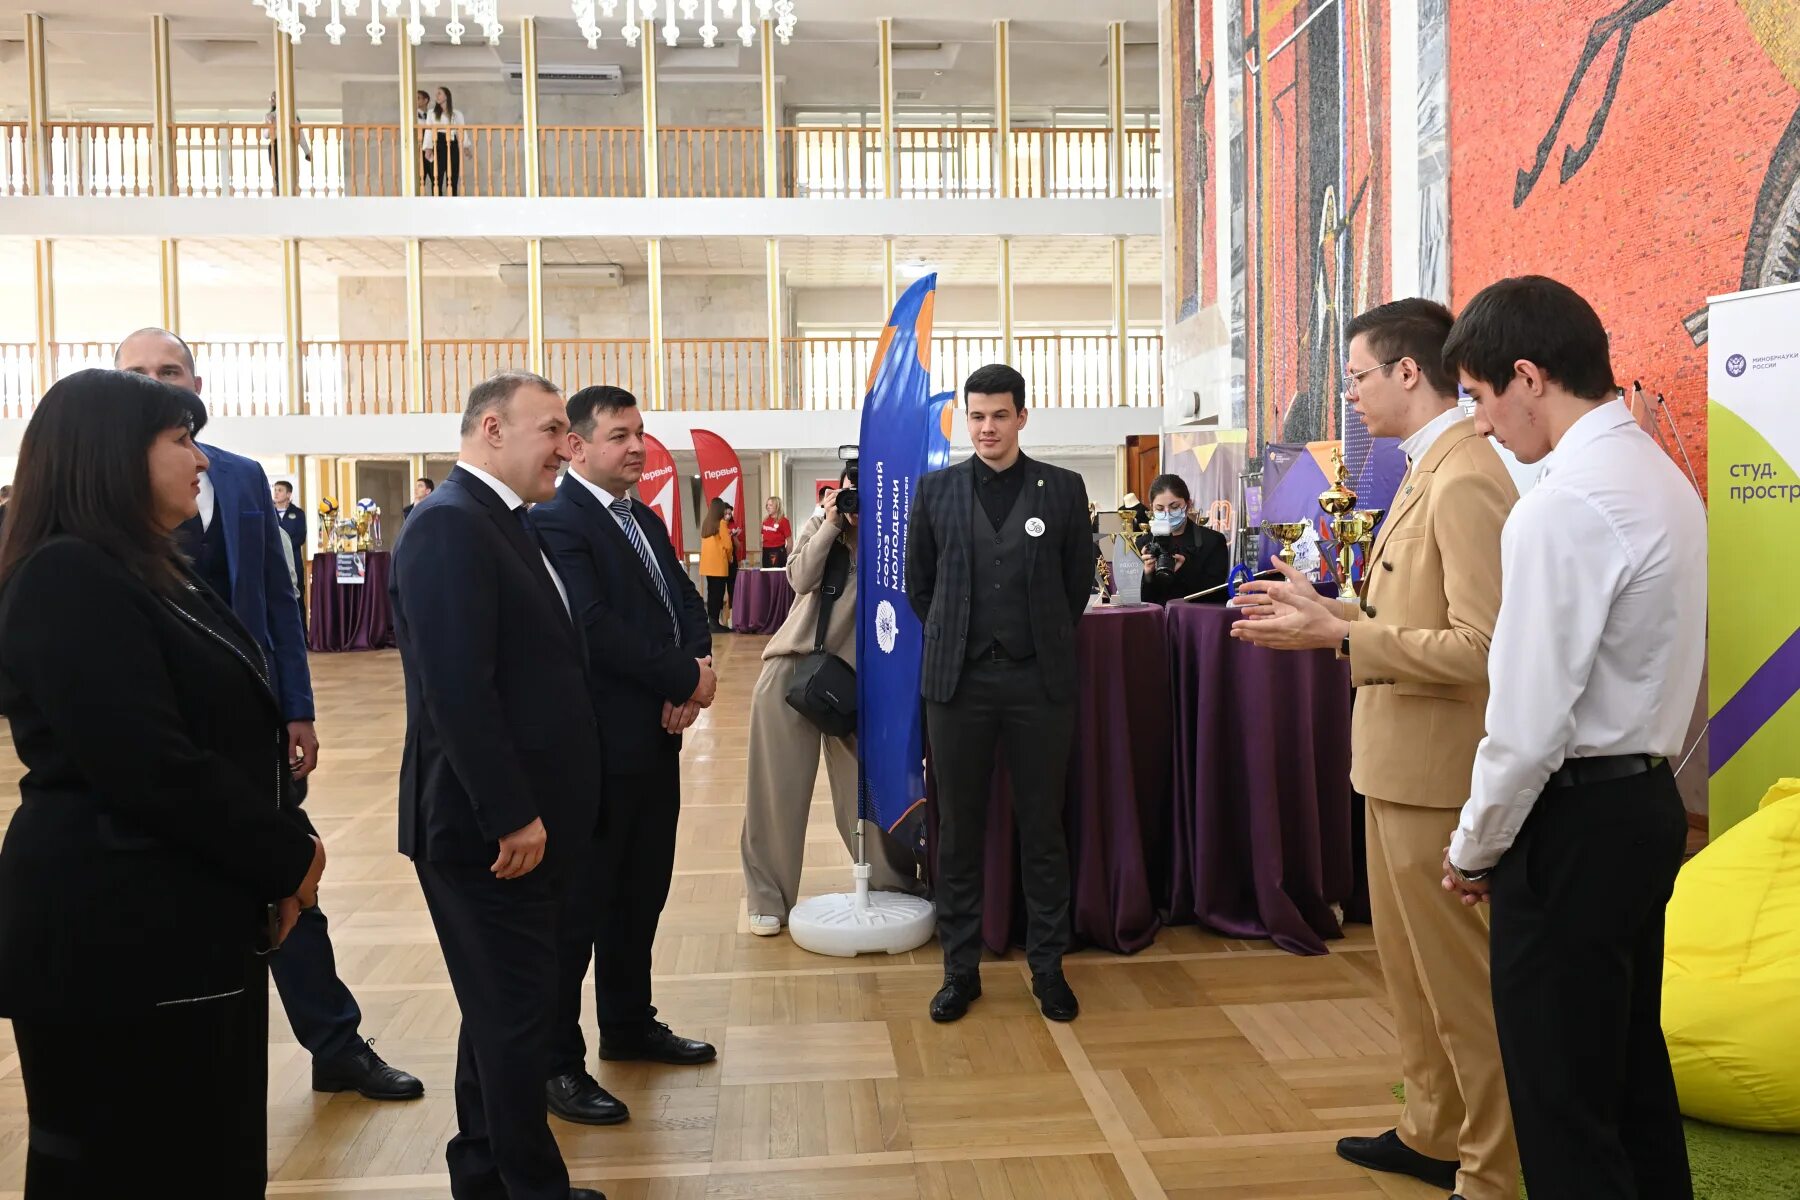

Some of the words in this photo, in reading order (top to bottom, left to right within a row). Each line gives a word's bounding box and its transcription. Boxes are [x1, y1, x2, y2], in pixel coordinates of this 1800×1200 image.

[1752, 353, 1799, 363] МИНОБРНАУКИ
[1752, 362, 1777, 370] РОССИИ
[704, 466, 738, 480] Первые
[1729, 463, 1777, 482] студ.
[1730, 484, 1800, 504] простр
[891, 479, 899, 590] МОЛОДЕЖИ
